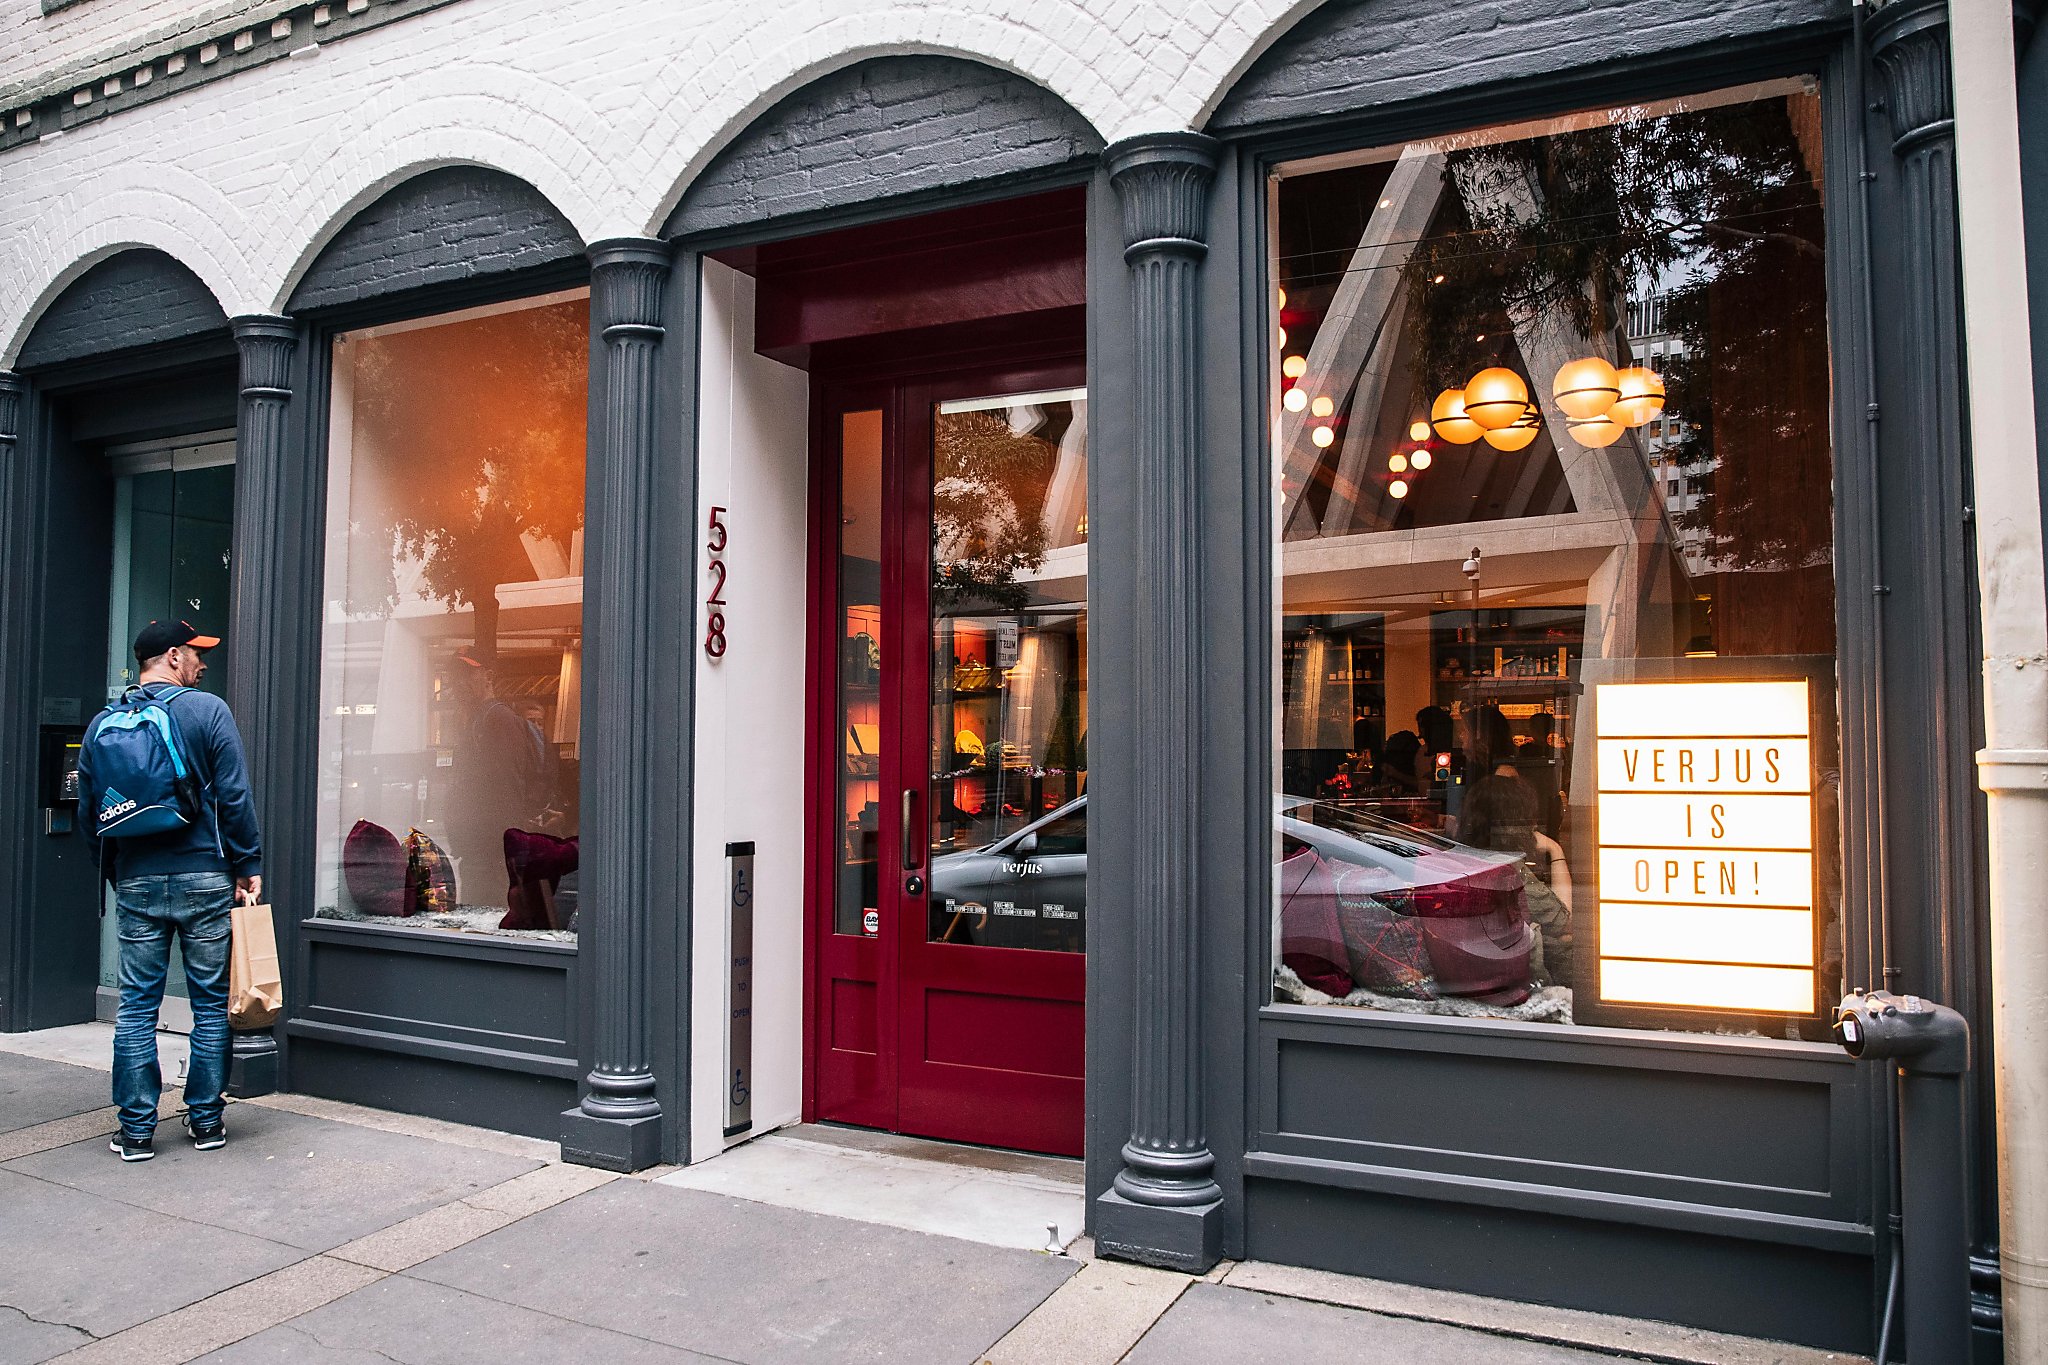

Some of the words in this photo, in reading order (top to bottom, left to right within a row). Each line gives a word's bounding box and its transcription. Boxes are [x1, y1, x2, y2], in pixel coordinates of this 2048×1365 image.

[705, 506, 728, 658] 528
[1623, 748, 1780, 783] VERJUS
[99, 799, 137, 822] adidas
[1686, 804, 1725, 839] IS
[1002, 859, 1043, 877] verjus
[1635, 859, 1759, 895] OPEN!
[737, 982, 747, 993] TO
